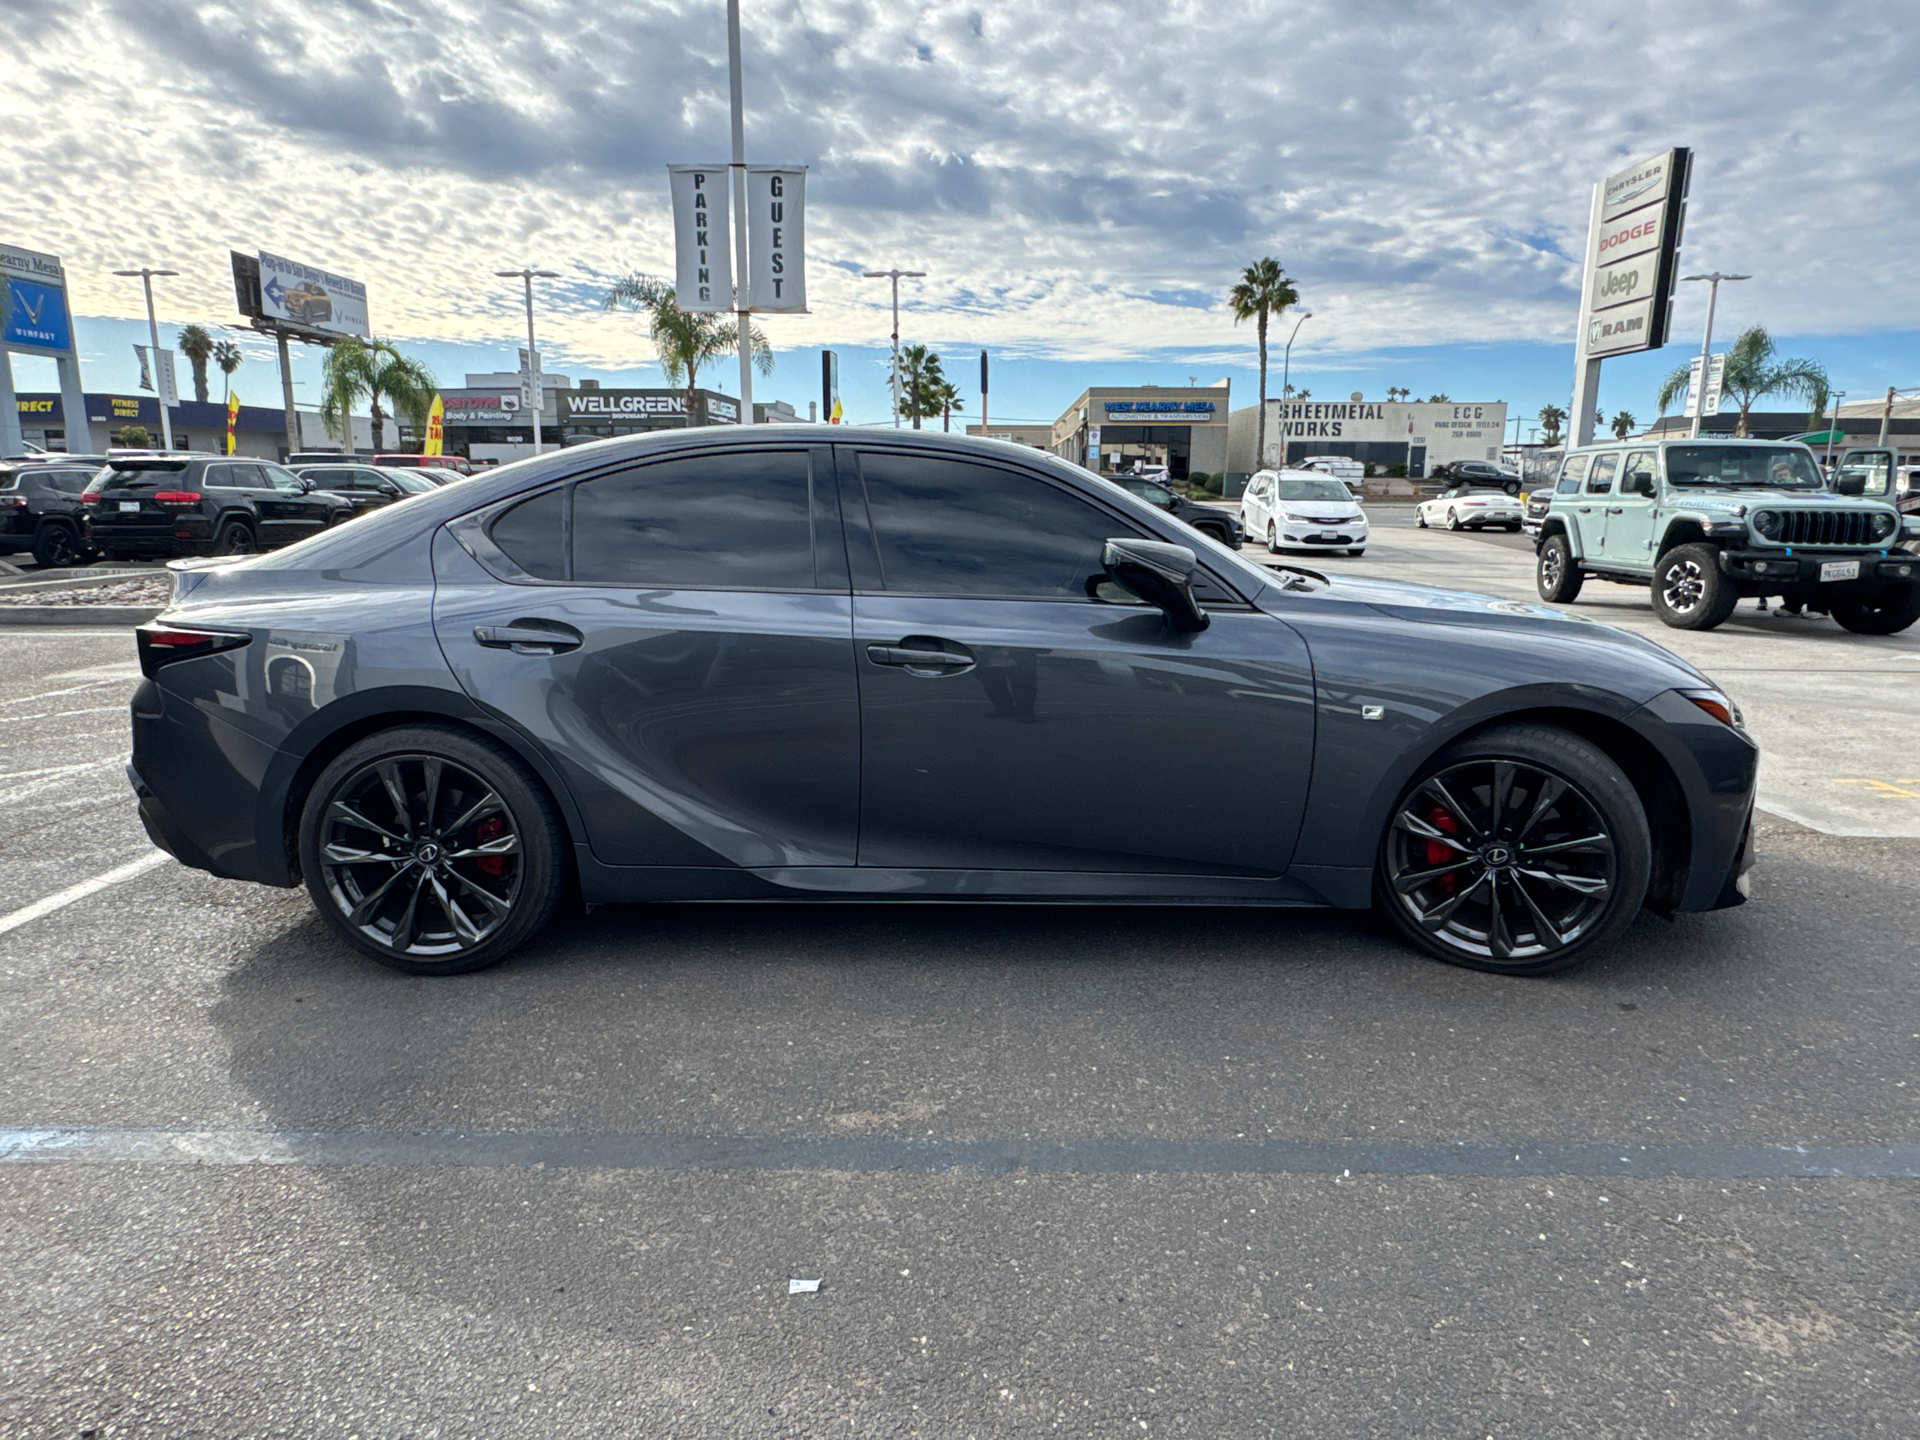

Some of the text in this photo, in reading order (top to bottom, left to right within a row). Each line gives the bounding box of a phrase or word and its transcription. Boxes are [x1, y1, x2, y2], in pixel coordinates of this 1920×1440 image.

[1606, 166, 1662, 196] CHRYSLER
[694, 173, 711, 302] PARKING
[770, 175, 784, 299] GUEST
[1598, 219, 1657, 252] DODGE
[0, 253, 60, 275] earny Mesa
[1600, 269, 1639, 298] Jeep
[15, 327, 56, 341] VINFAST
[1601, 316, 1644, 337] RAM
[16, 401, 54, 412] IRECT
[111, 399, 139, 408] FITNESS
[1104, 402, 1215, 412] WEST KEARNY MESA
[113, 408, 139, 417] DIRECT
[446, 412, 468, 421] Body
[478, 412, 512, 421] Painting
[1279, 404, 1384, 420] SHEETMETAL
[1279, 421, 1342, 437] WORKS
